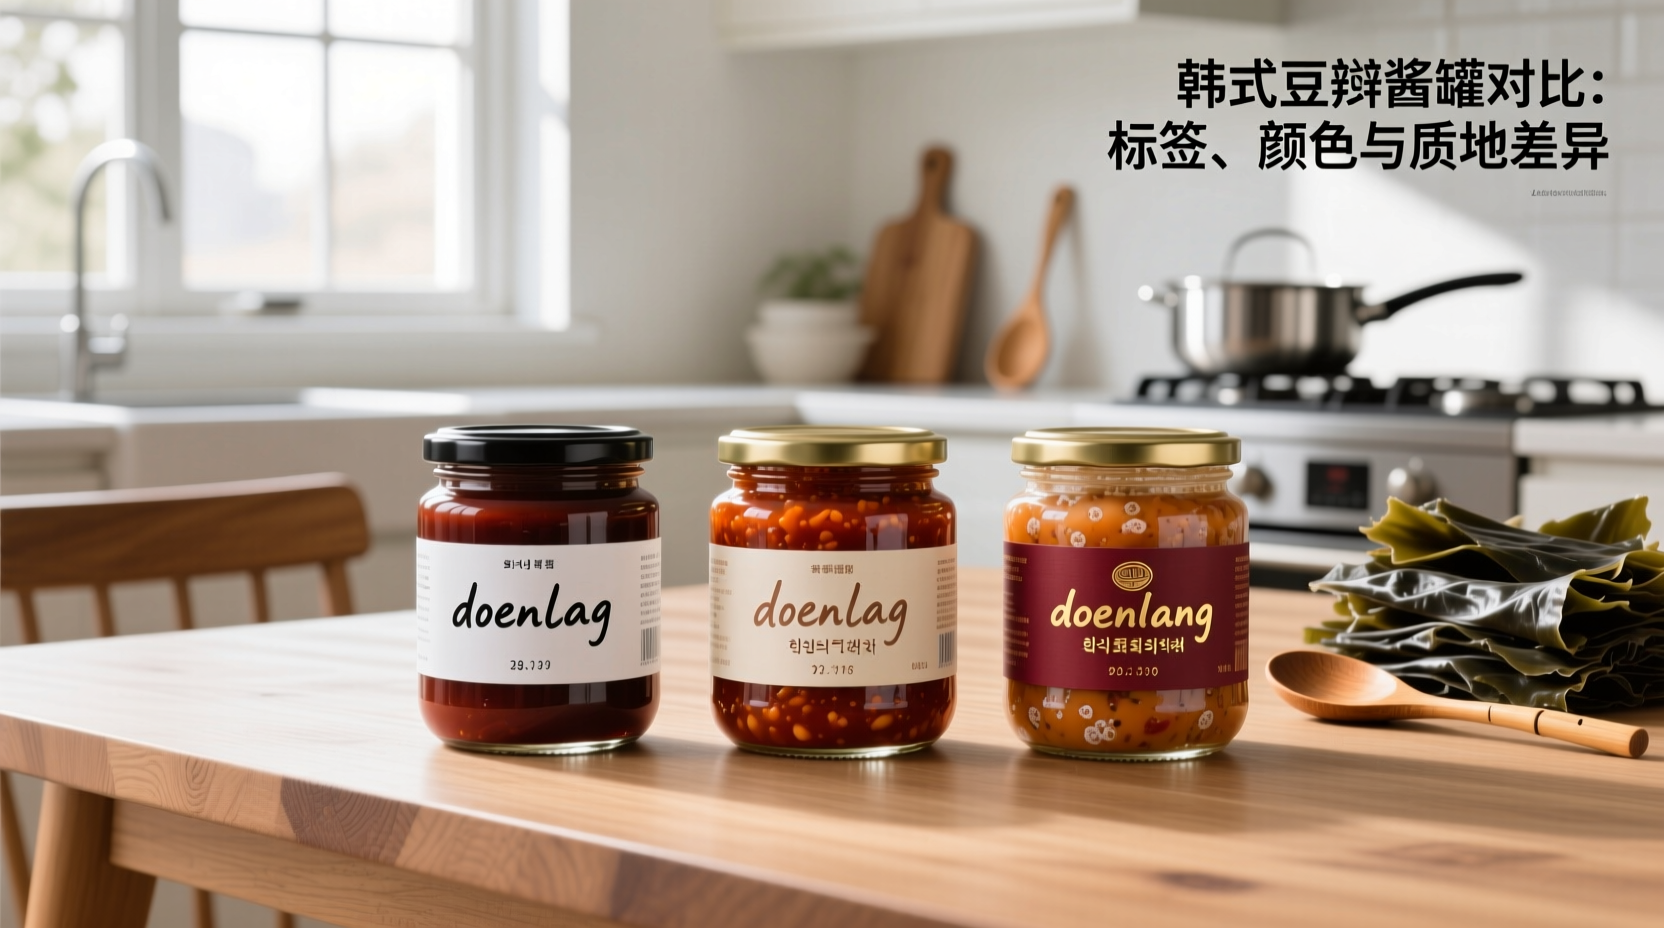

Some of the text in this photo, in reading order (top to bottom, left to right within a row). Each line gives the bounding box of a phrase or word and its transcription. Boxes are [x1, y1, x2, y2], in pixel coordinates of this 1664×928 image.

[452, 581, 612, 647] doenlag
[753, 579, 908, 646] doenlag
[1050, 587, 1213, 643] doenlang
